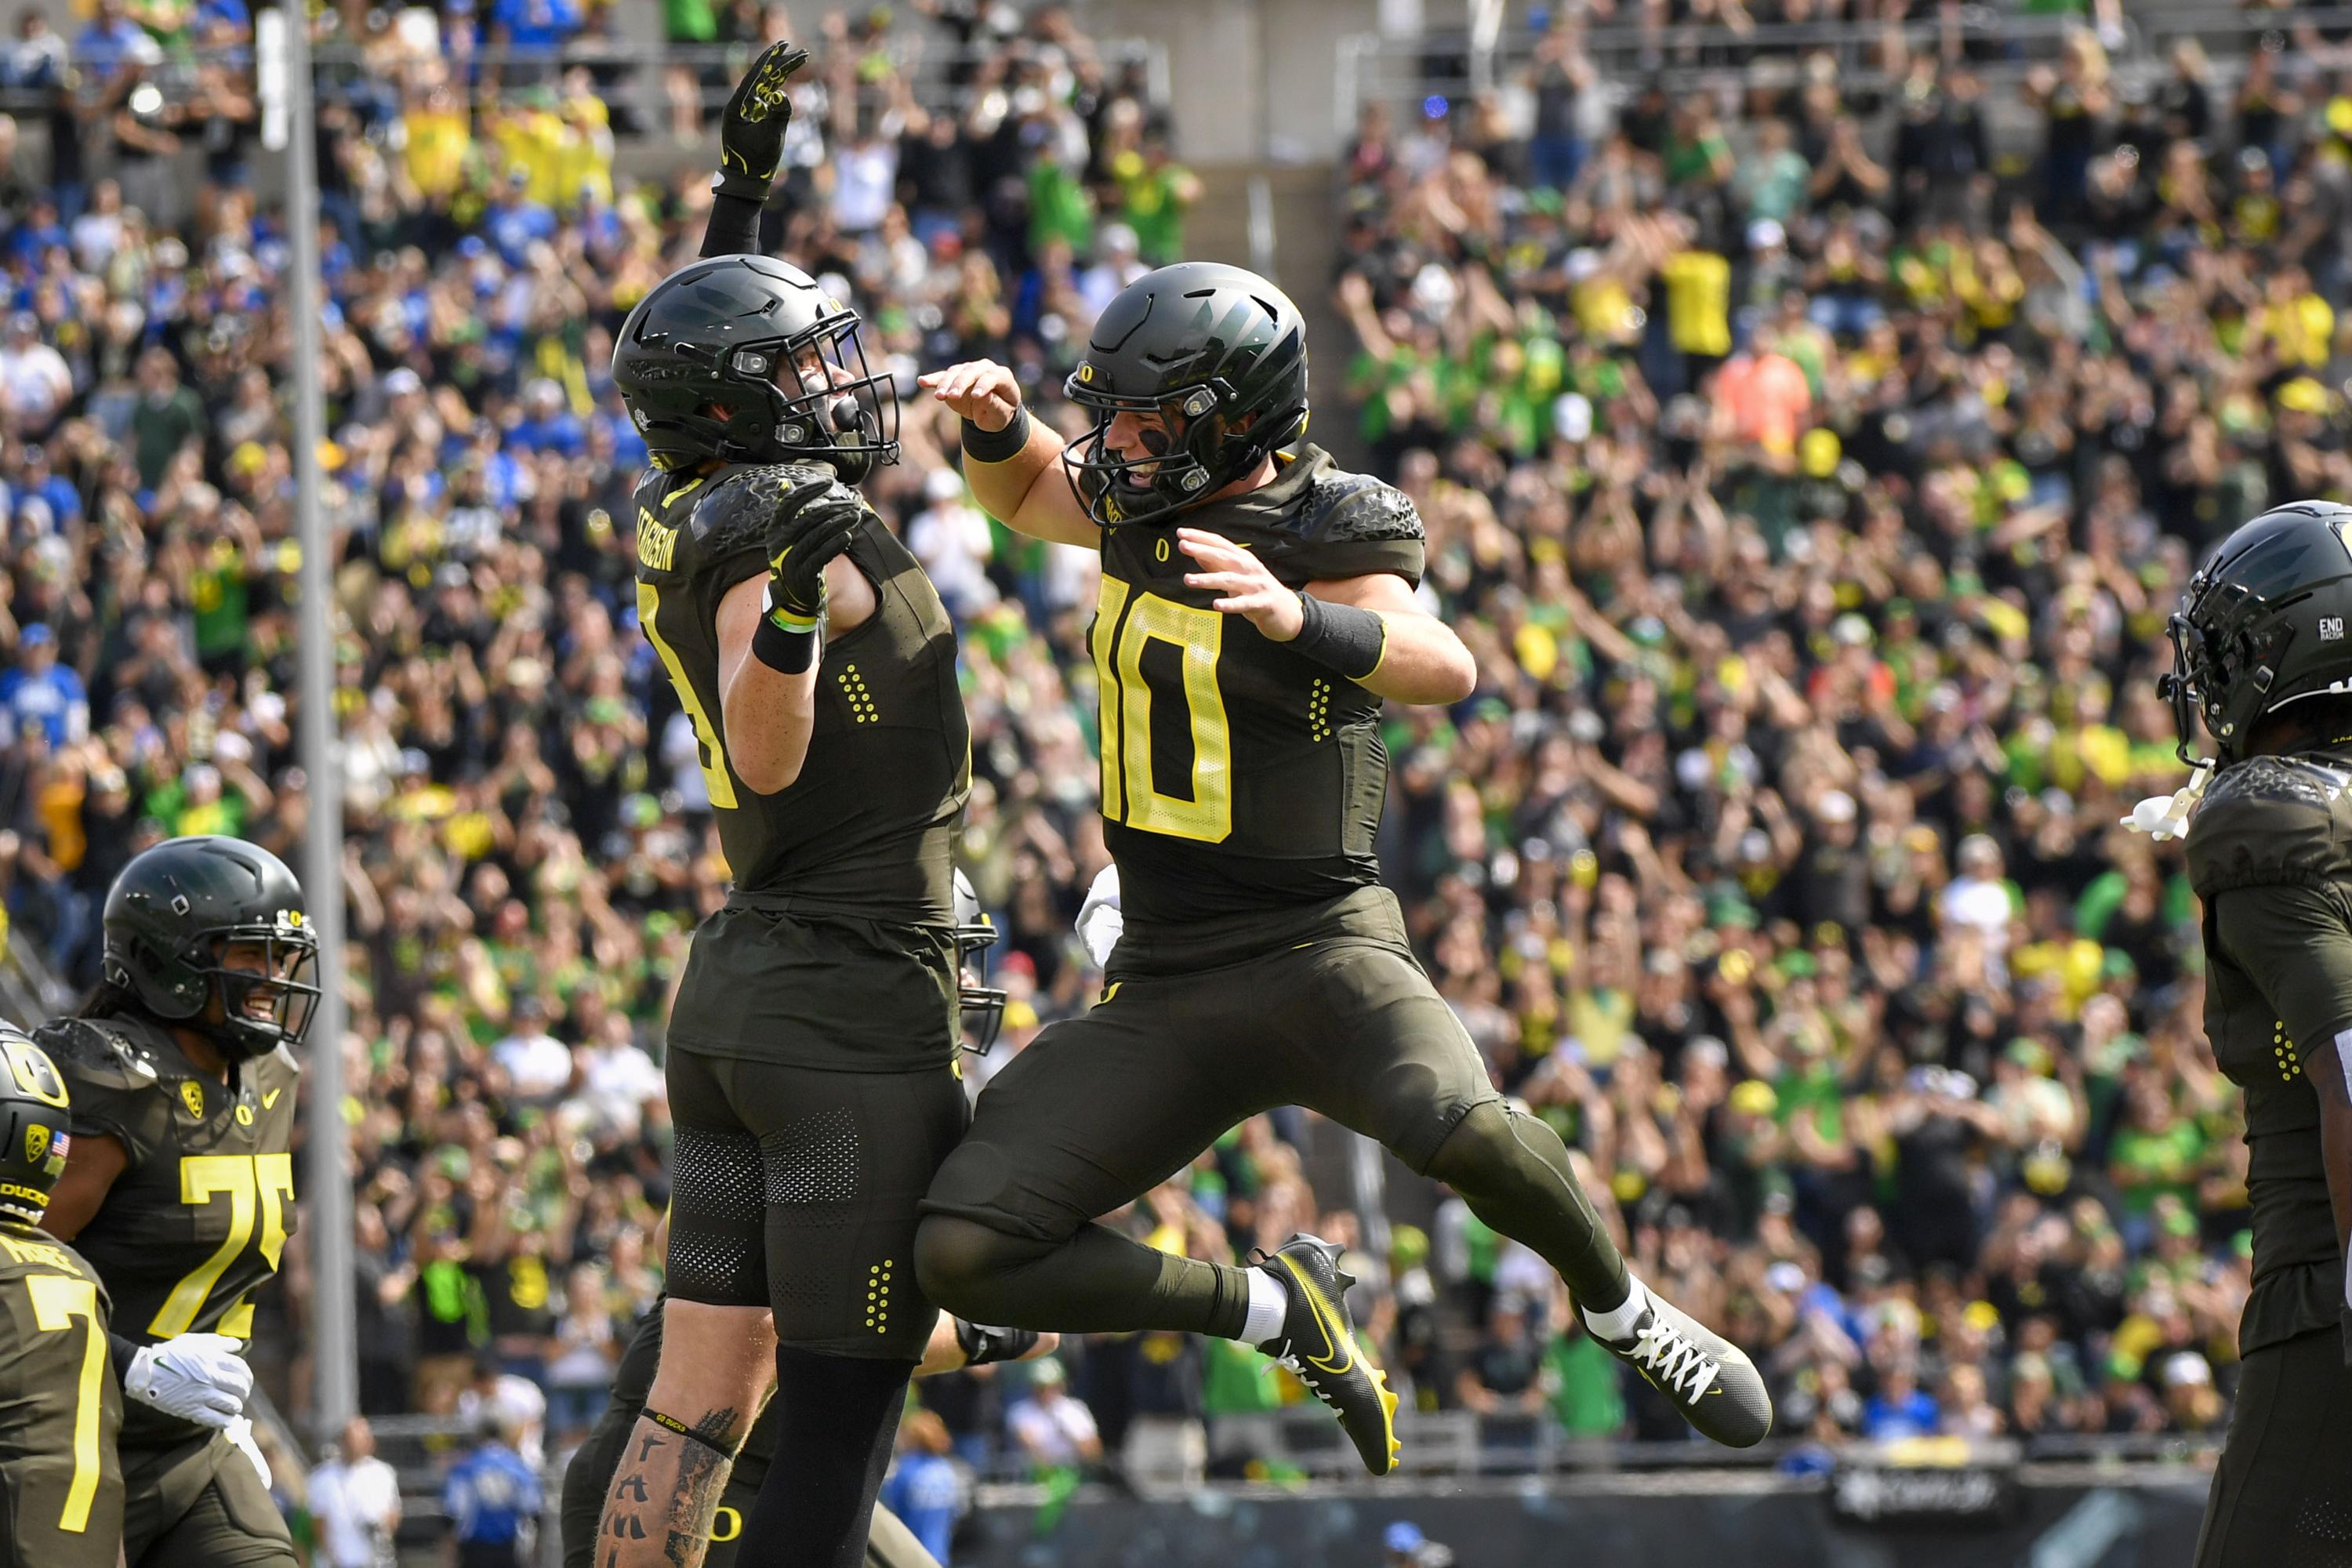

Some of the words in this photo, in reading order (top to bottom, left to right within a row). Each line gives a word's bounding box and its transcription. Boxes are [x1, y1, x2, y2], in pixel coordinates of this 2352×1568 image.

[2319, 617, 2343, 633] END
[1092, 572, 1232, 844] 10
[1, 1184, 50, 1207] DUCKS
[26, 1275, 107, 1533] 7
[656, 1414, 666, 1422] GO
[666, 1418, 686, 1432] DUCKS
